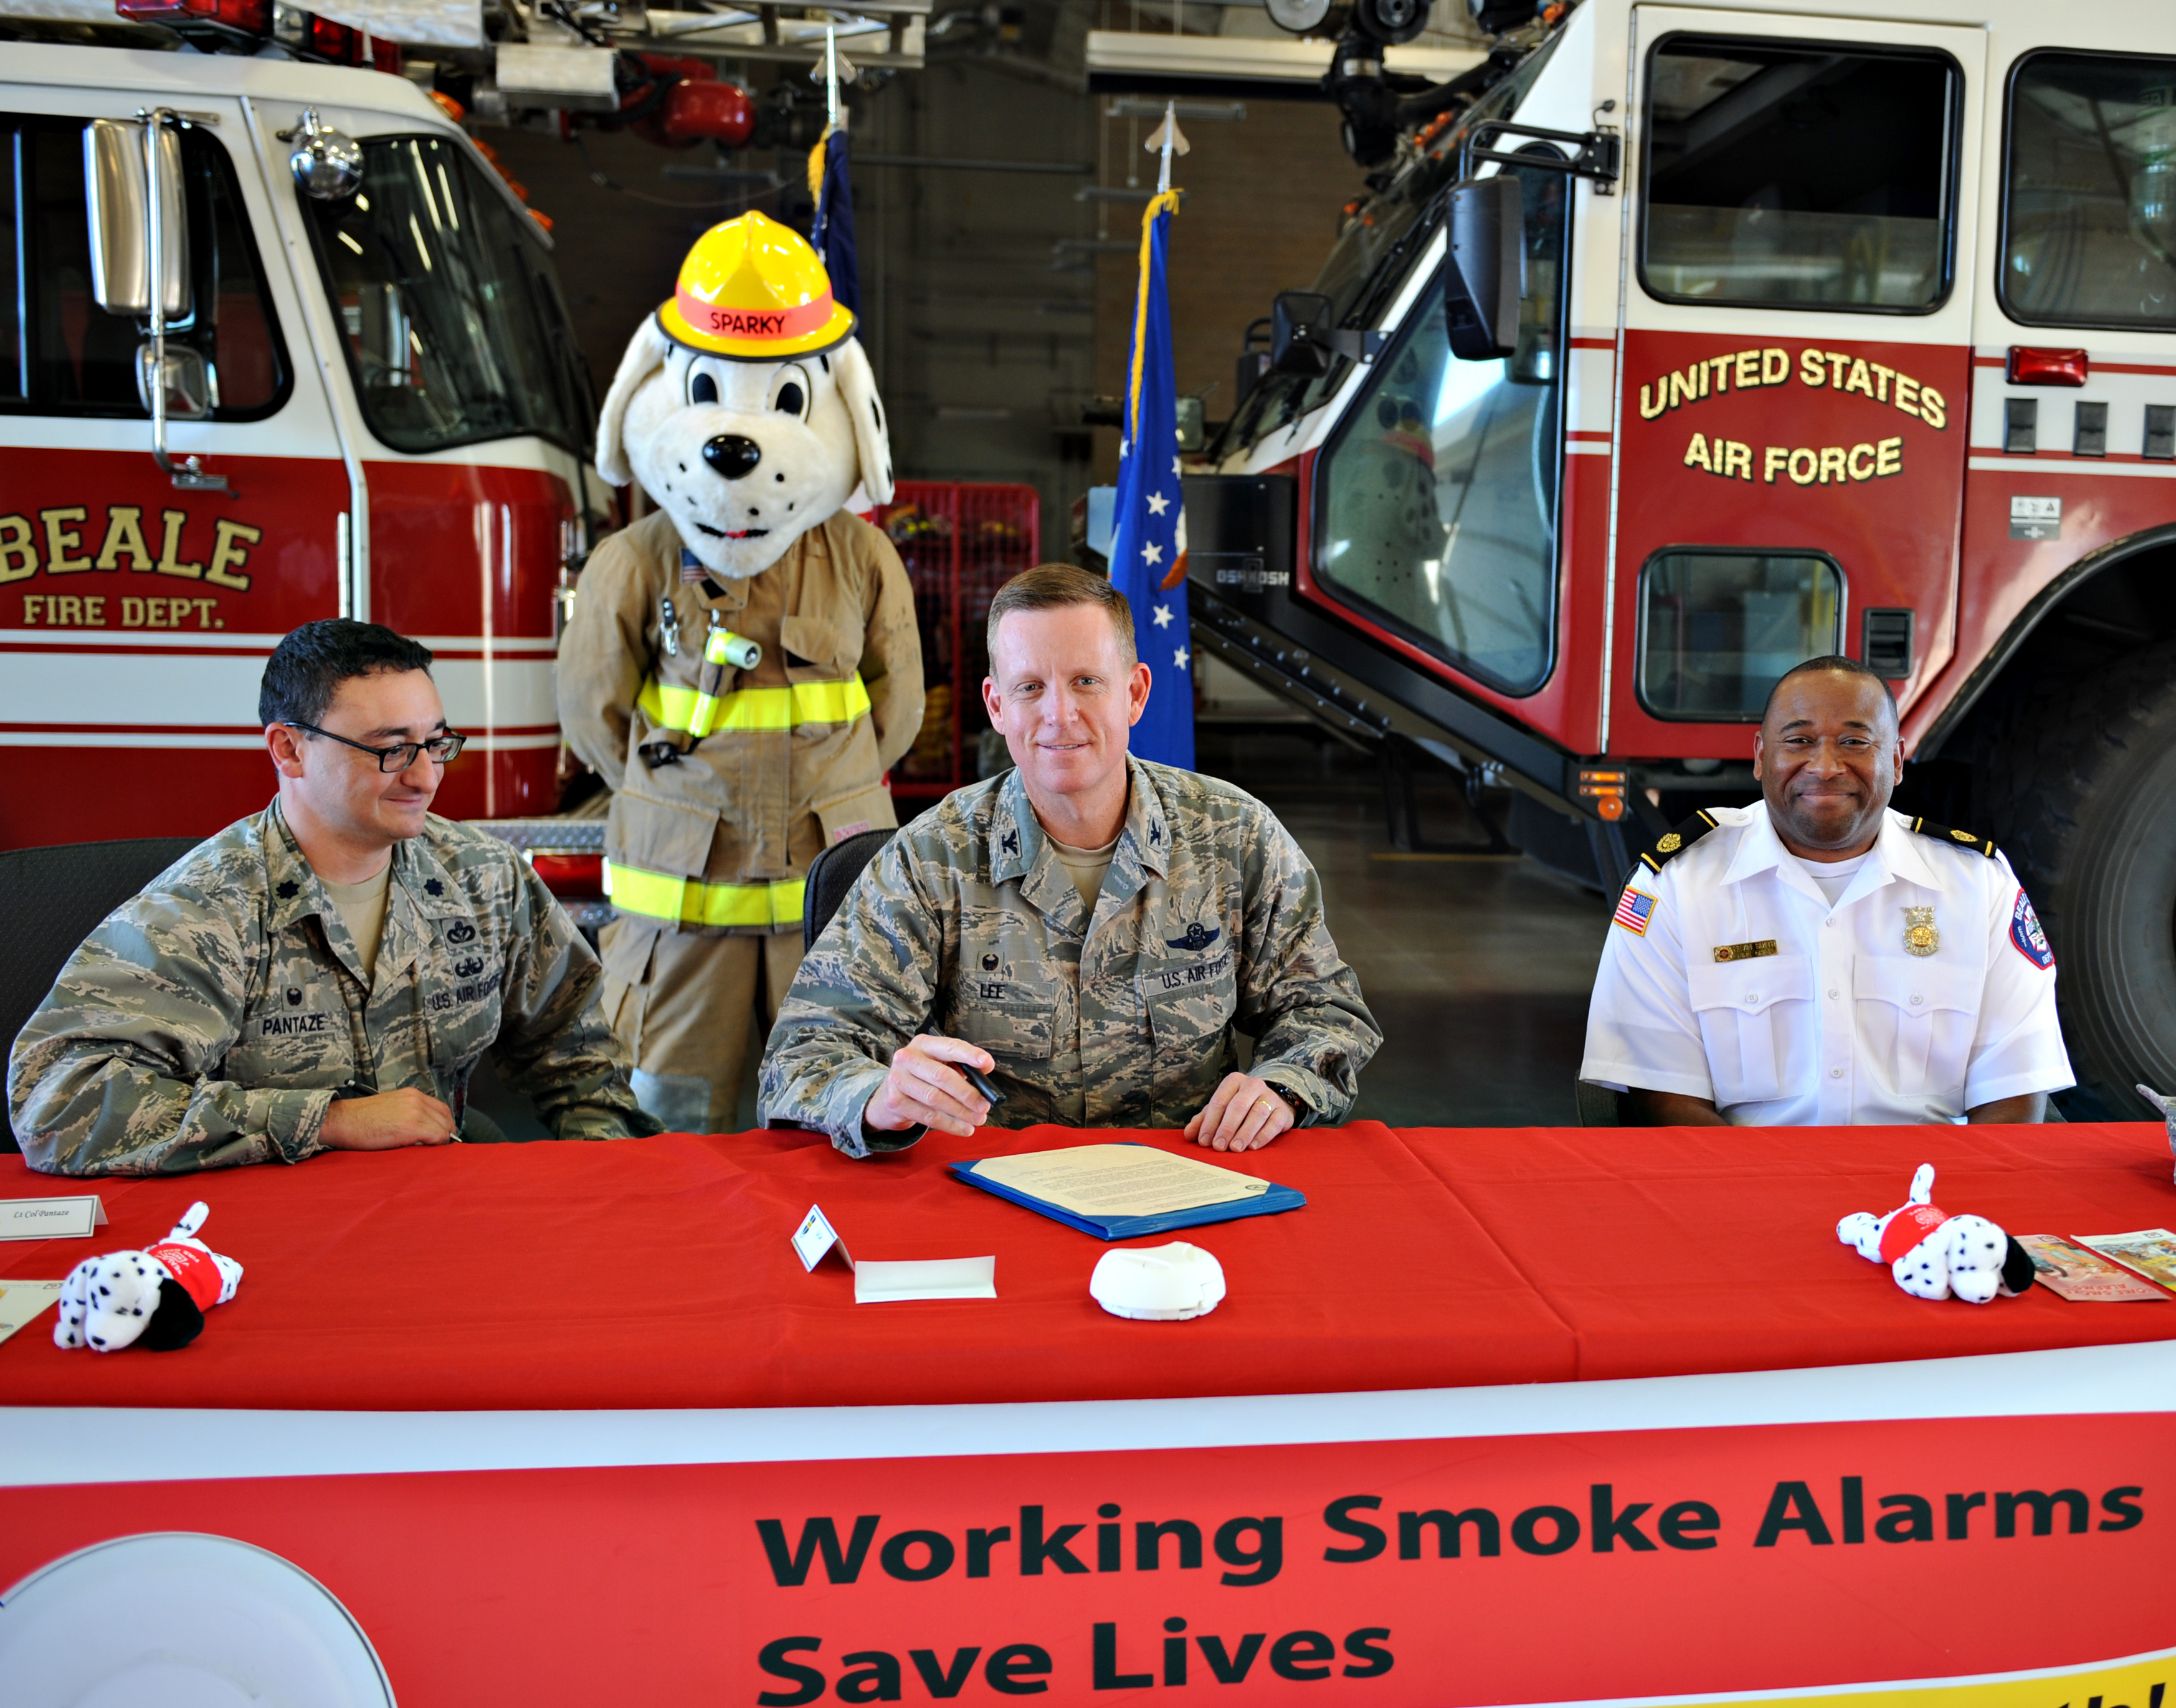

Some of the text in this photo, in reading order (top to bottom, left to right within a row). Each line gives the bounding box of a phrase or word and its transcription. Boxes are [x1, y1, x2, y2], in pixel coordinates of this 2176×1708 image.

[710, 312, 785, 334] SPARKY
[1640, 348, 1947, 429] UNITED STATES
[1683, 432, 1903, 485] AIR FORCE
[0, 505, 262, 591] BEALE
[23, 594, 225, 629] FIRE DEPT.
[980, 984, 1005, 999] LEE
[1161, 971, 1185, 989] U.S.
[1187, 965, 1206, 984] AIR
[432, 993, 454, 1010] U.S.
[456, 985, 474, 1005] AIR
[262, 1013, 325, 1035] PANTAZE
[24, 1209, 39, 1218] Col
[755, 1475, 2145, 1588] Working Smoke Alarms
[756, 1616, 1395, 1707] Save Lives
